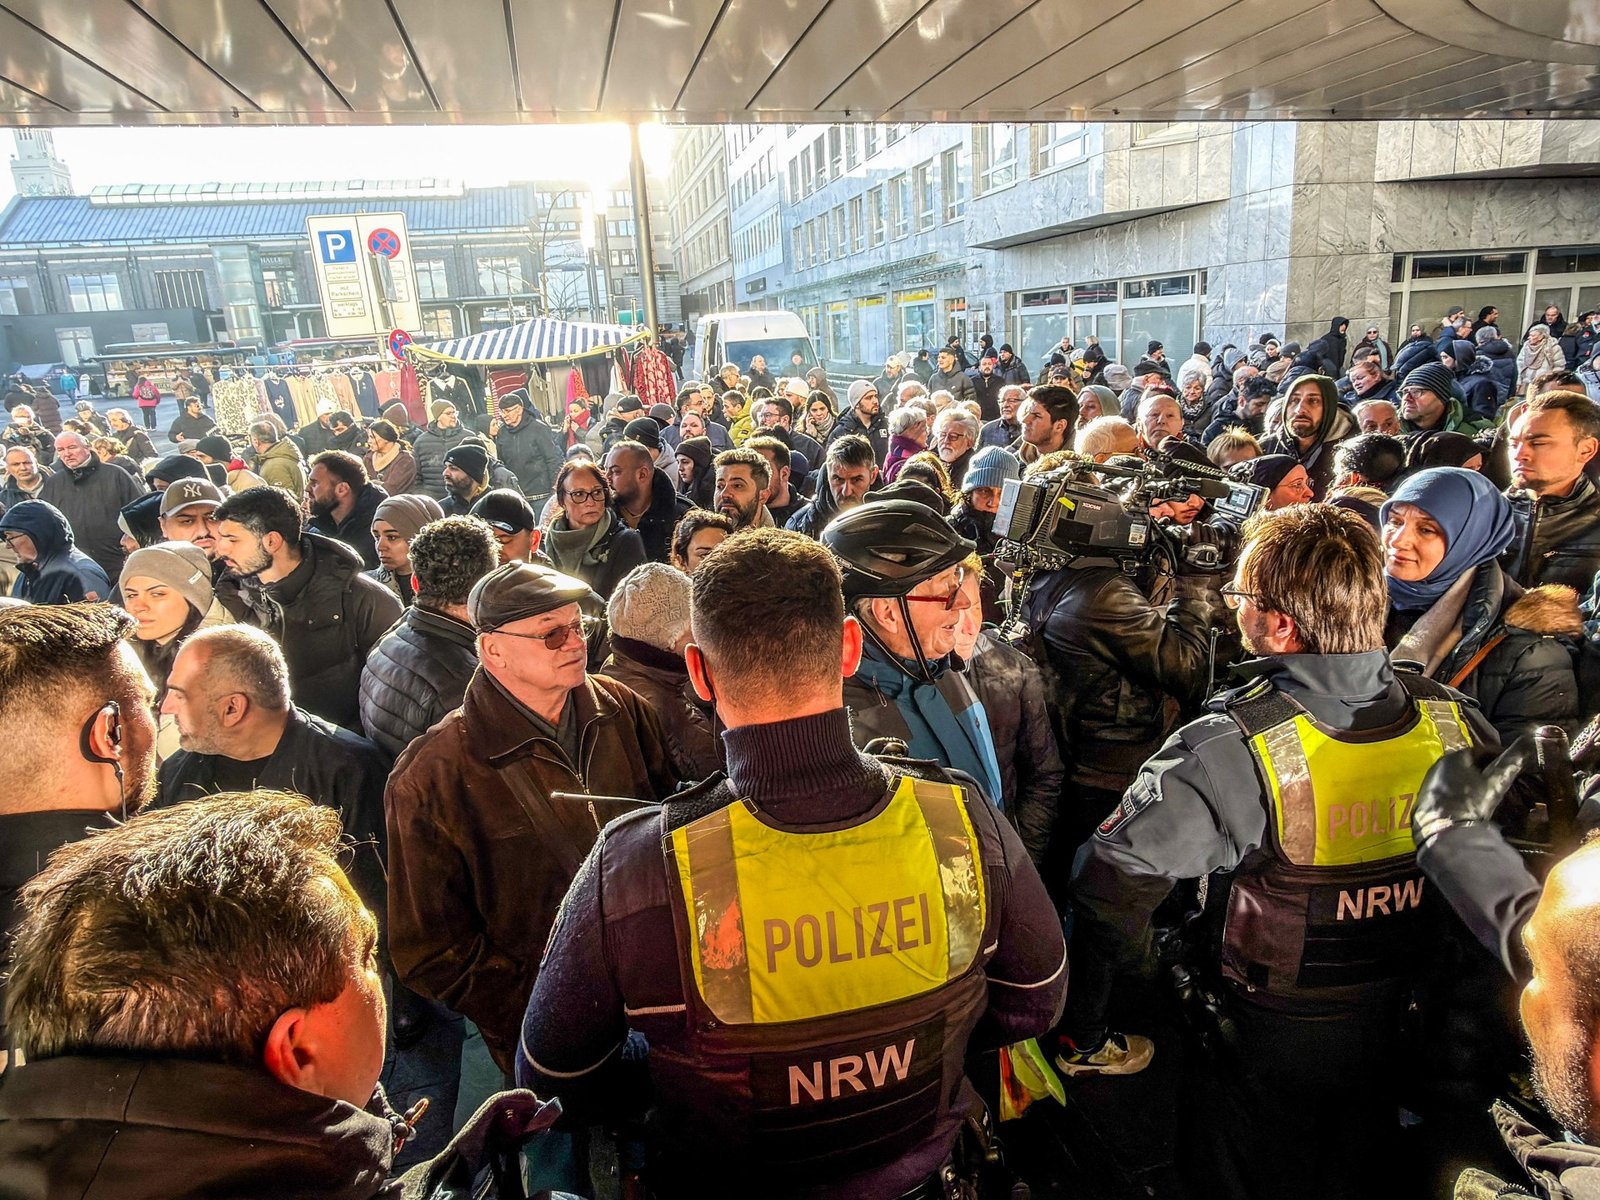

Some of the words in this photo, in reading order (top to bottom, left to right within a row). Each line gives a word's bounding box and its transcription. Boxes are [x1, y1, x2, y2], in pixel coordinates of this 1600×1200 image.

[326, 234, 346, 260] P
[1328, 793, 1413, 841] POLIZ
[1336, 877, 1425, 921] NRW
[763, 892, 932, 974] POLIZEI
[788, 1038, 916, 1105] NRW
